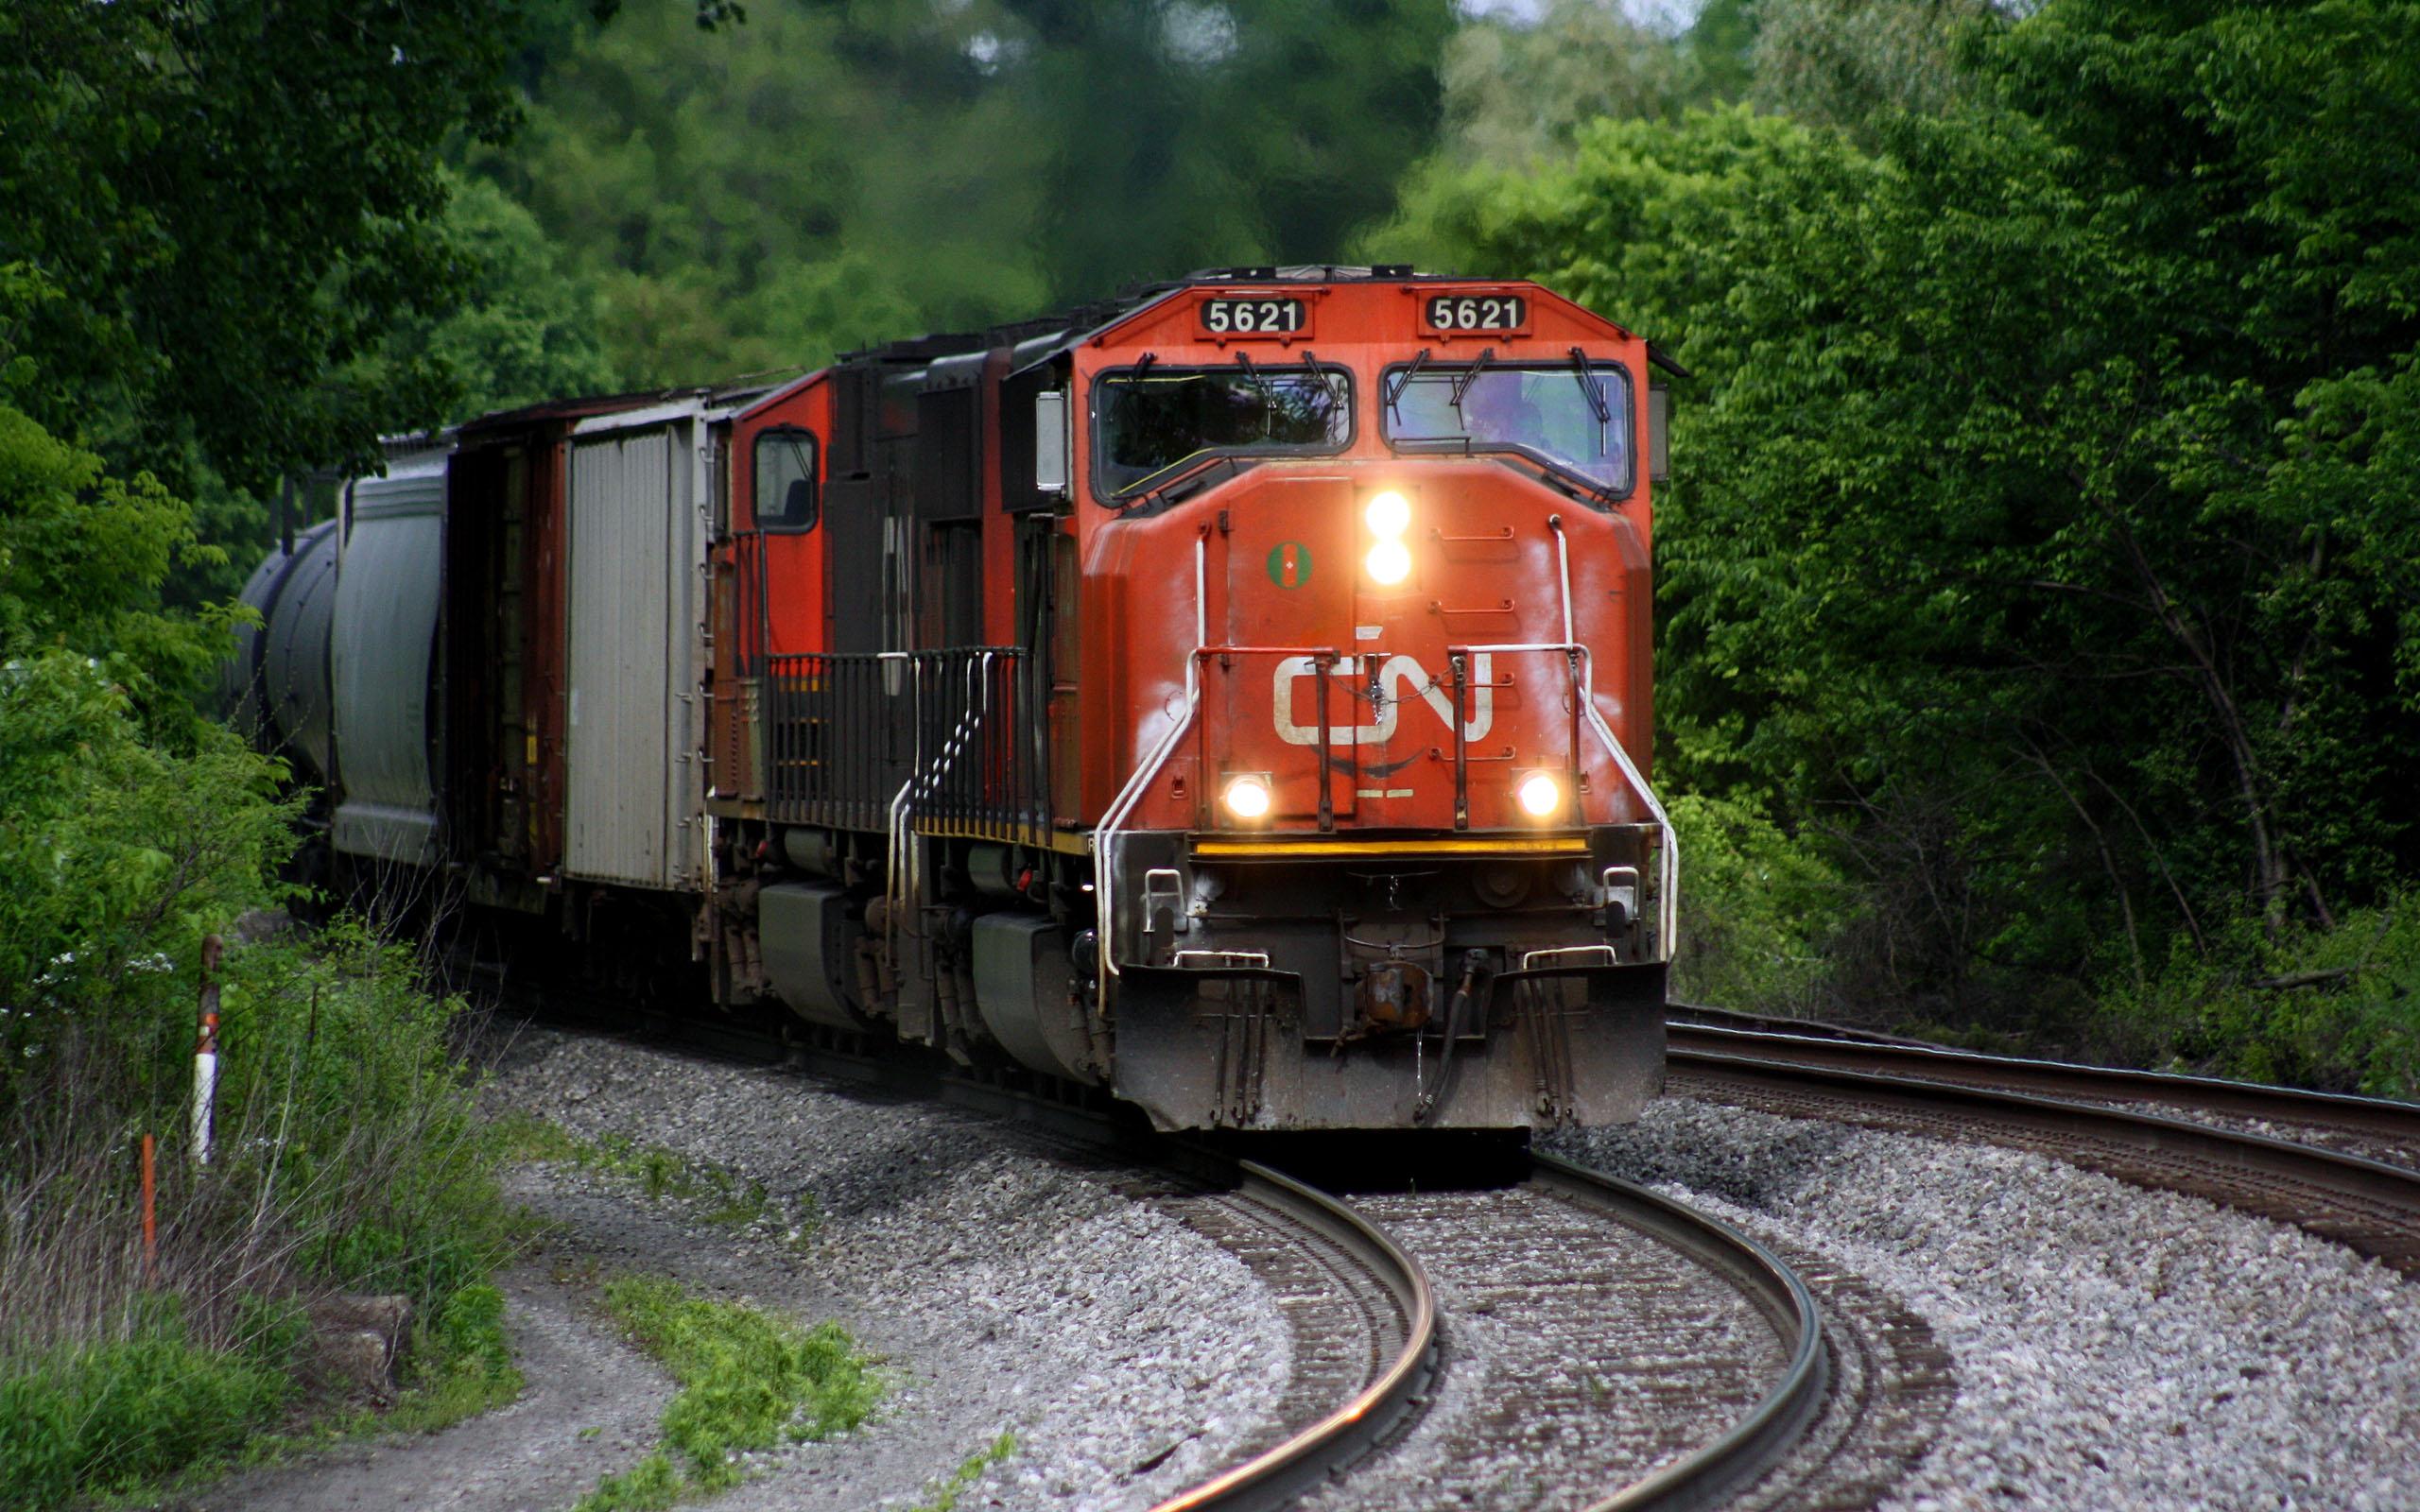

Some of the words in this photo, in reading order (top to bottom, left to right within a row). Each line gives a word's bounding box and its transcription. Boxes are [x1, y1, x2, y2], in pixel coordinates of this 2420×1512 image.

[1209, 301, 1296, 332] 5621
[1434, 298, 1517, 329] 5621
[1273, 653, 1493, 745] CN
